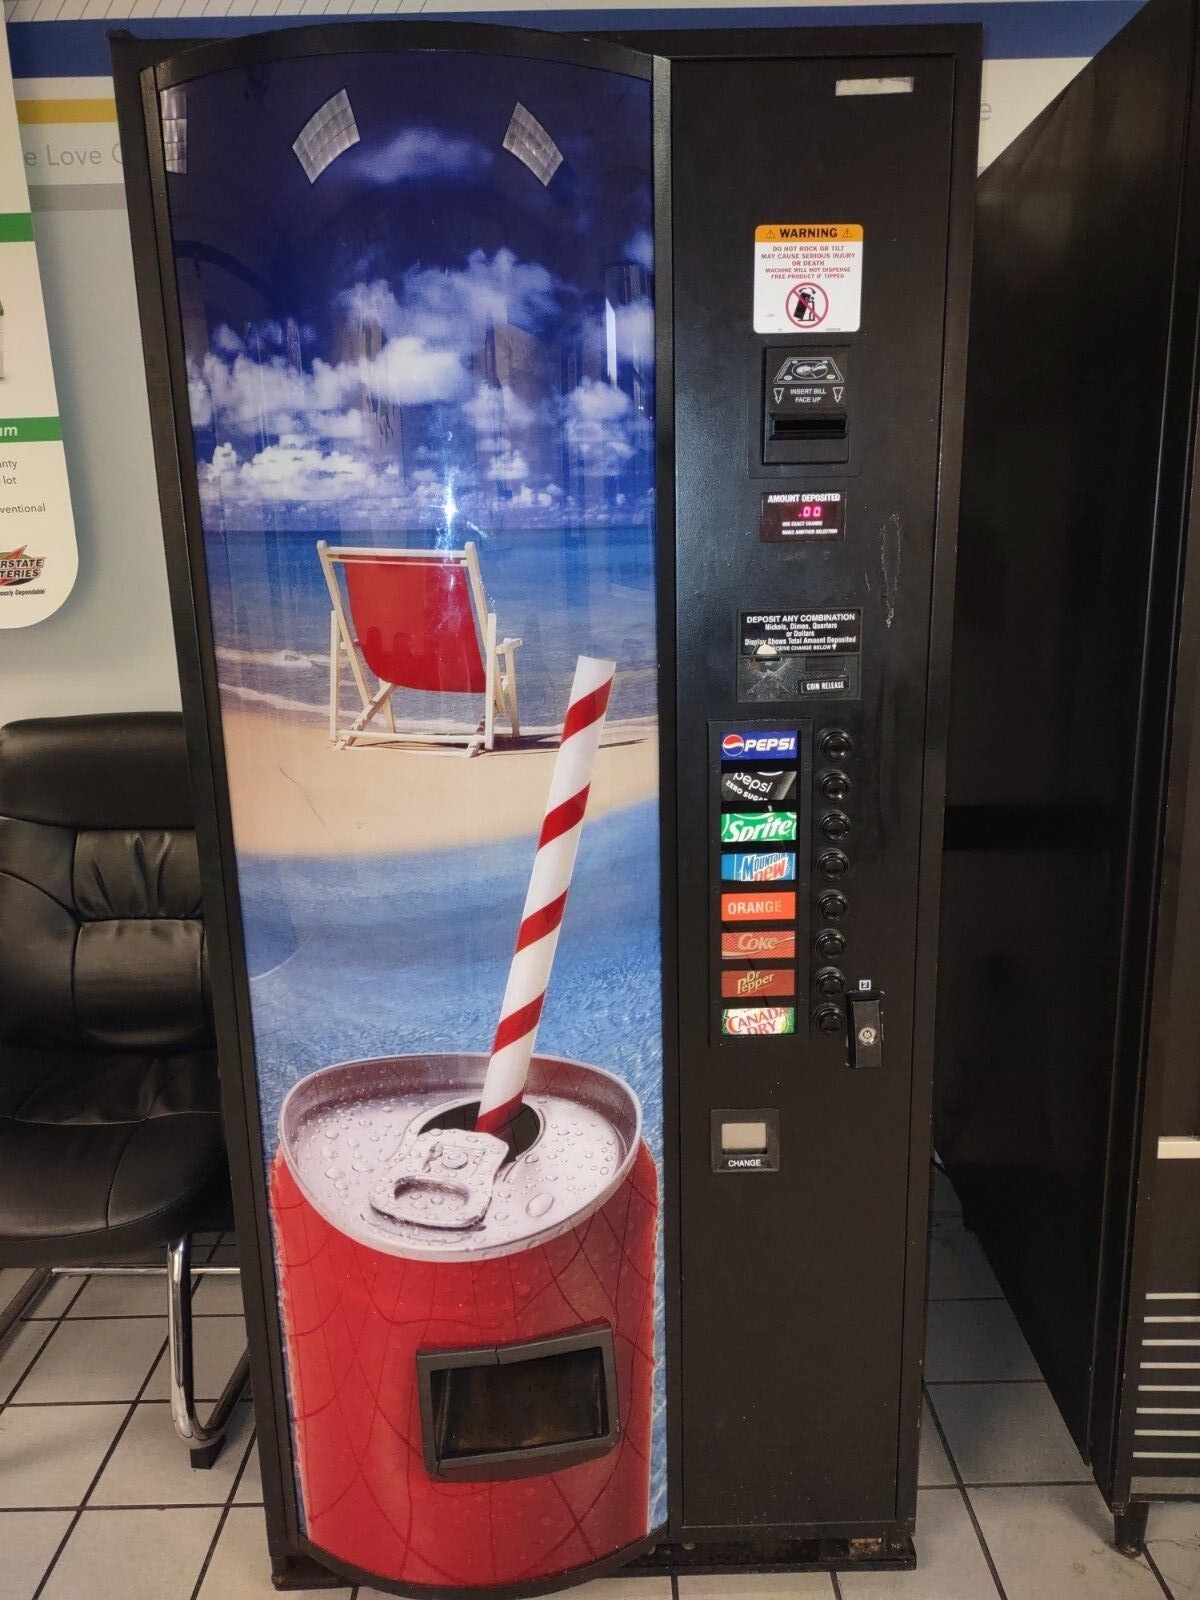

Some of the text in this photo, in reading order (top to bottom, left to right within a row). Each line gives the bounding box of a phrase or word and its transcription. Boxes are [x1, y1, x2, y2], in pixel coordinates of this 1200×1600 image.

[24, 150, 37, 167] e
[46, 144, 102, 166] Love
[780, 228, 837, 238] WARNING
[2, 475, 17, 485] lot
[768, 493, 840, 503] AMOUNT DEPOSITED
[800, 614, 855, 622] COMBINATION
[744, 738, 796, 752] PEPSI
[726, 780, 742, 794] ZERO
[733, 772, 773, 793] pepsi
[725, 816, 792, 842] Sprite
[728, 900, 782, 915] ORANGE
[738, 932, 778, 950] Coke
[746, 971, 760, 982] Dr
[737, 974, 774, 994] Pepper
[726, 1007, 788, 1034] CANADA
[747, 1020, 776, 1034] DRY
